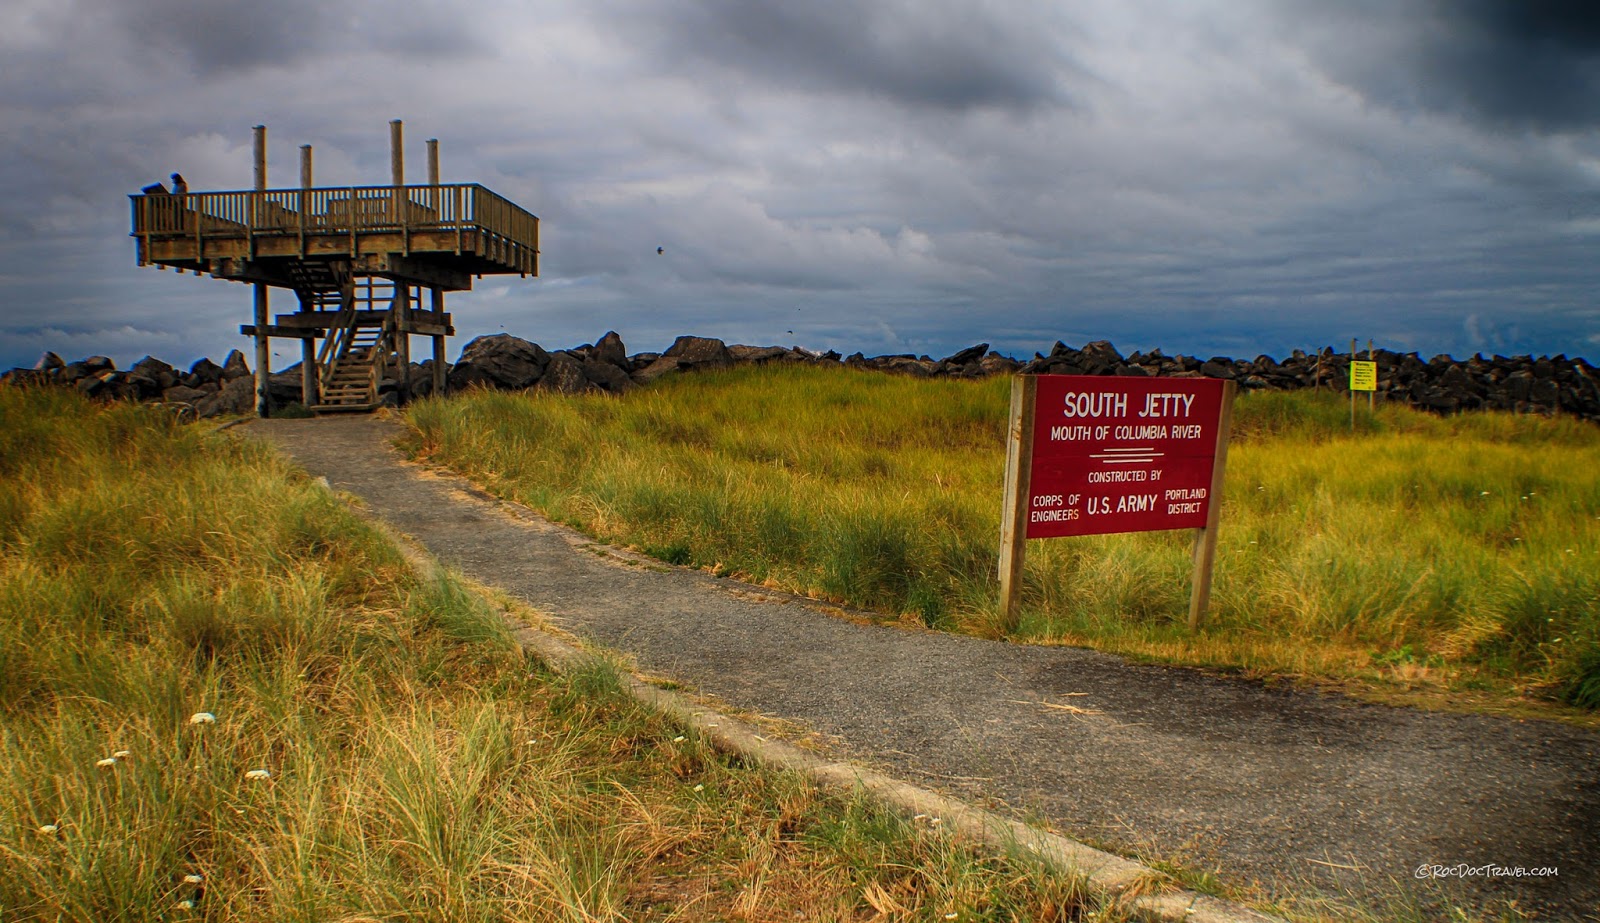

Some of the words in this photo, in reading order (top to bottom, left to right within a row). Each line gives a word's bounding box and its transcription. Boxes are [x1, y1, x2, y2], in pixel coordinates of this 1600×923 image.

[1063, 392, 1127, 418] SOUTH
[1138, 393, 1195, 418] JETTY
[1051, 426, 1091, 441] MOUTH
[1095, 425, 1110, 440] OF
[1115, 425, 1168, 440] COLUMBIA
[1171, 425, 1201, 439] RIVER
[1088, 470, 1146, 483] CONSTRUCTED
[1150, 470, 1162, 481] BY
[1033, 495, 1063, 507] CORPS
[1068, 494, 1080, 506] OF
[1165, 488, 1206, 501] PORTLAND
[1087, 496, 1113, 515] U.S.
[1117, 494, 1158, 513] ARMY
[1168, 502, 1201, 515] DISTRICT
[1031, 509, 1079, 522] ENGINEERS
